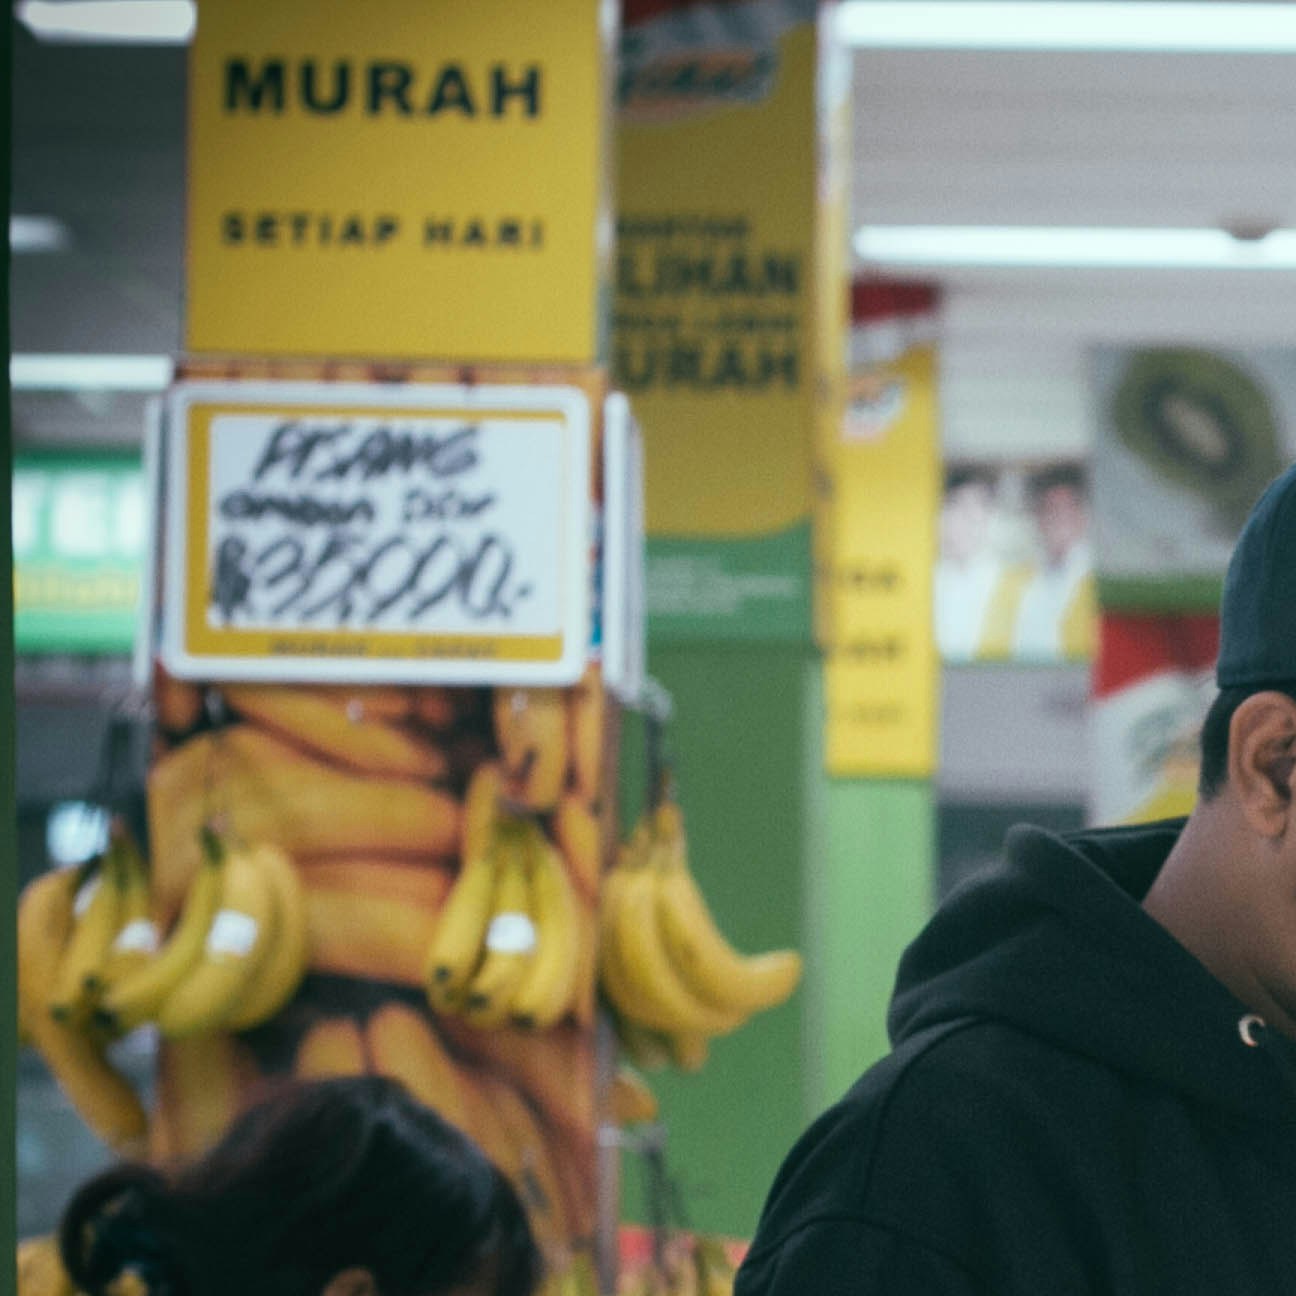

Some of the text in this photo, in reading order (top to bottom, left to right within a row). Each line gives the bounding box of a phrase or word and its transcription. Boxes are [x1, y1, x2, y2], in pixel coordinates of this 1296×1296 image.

[223, 60, 543, 117] MURAH
[223, 215, 545, 250] SETIAP HARI
